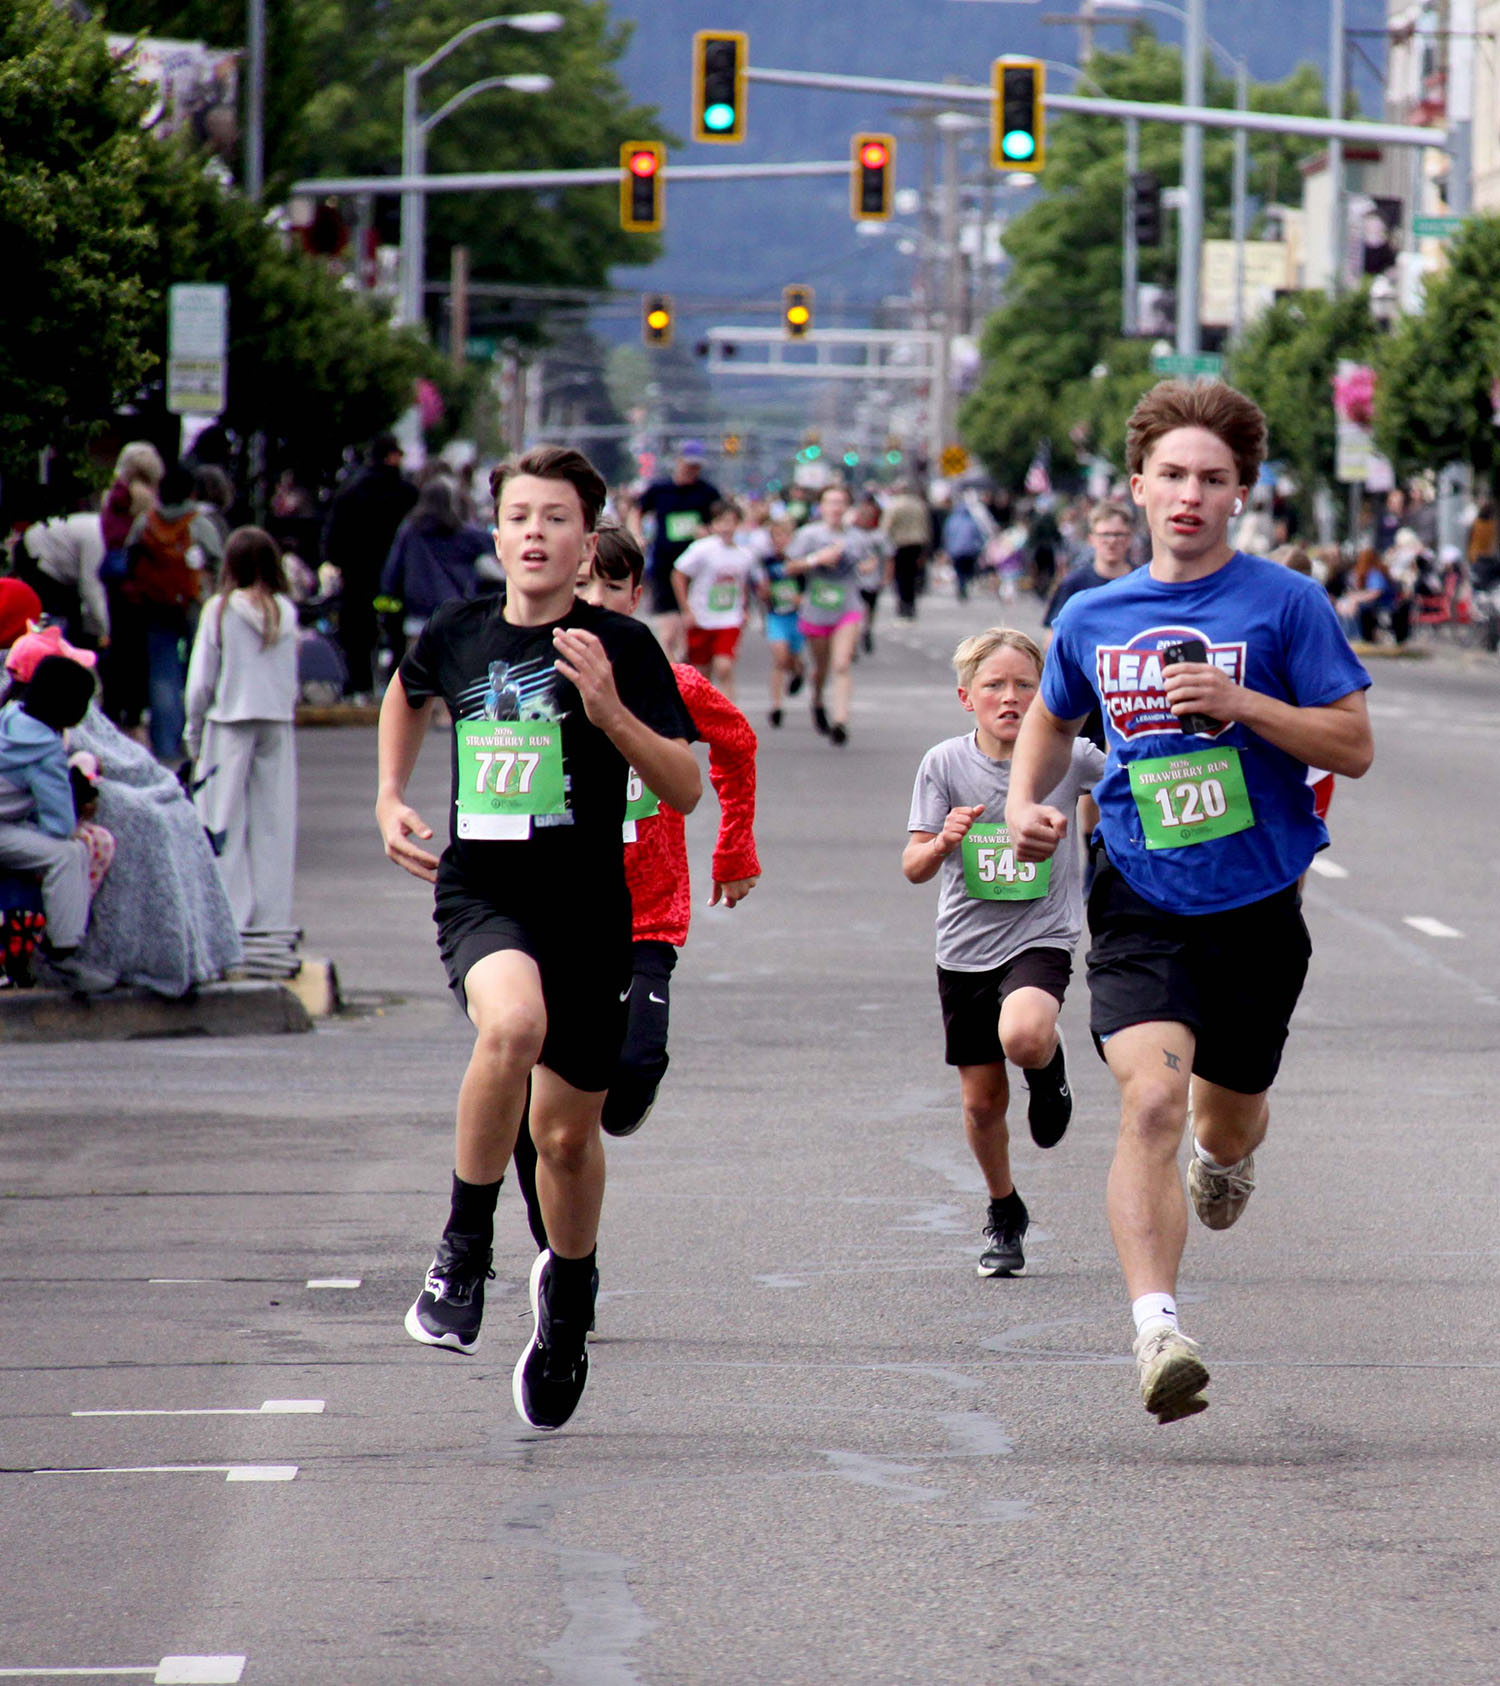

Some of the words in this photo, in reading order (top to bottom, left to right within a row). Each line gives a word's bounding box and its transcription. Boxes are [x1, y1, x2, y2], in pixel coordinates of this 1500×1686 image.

[1102, 651, 1238, 692] LEAE
[466, 736, 525, 746] STRAWBERRY
[529, 736, 551, 746] RUN
[475, 752, 541, 794] 777
[1139, 765, 1204, 785] STRAWBERRY
[1207, 760, 1229, 774] RUN
[1155, 779, 1227, 827] 120
